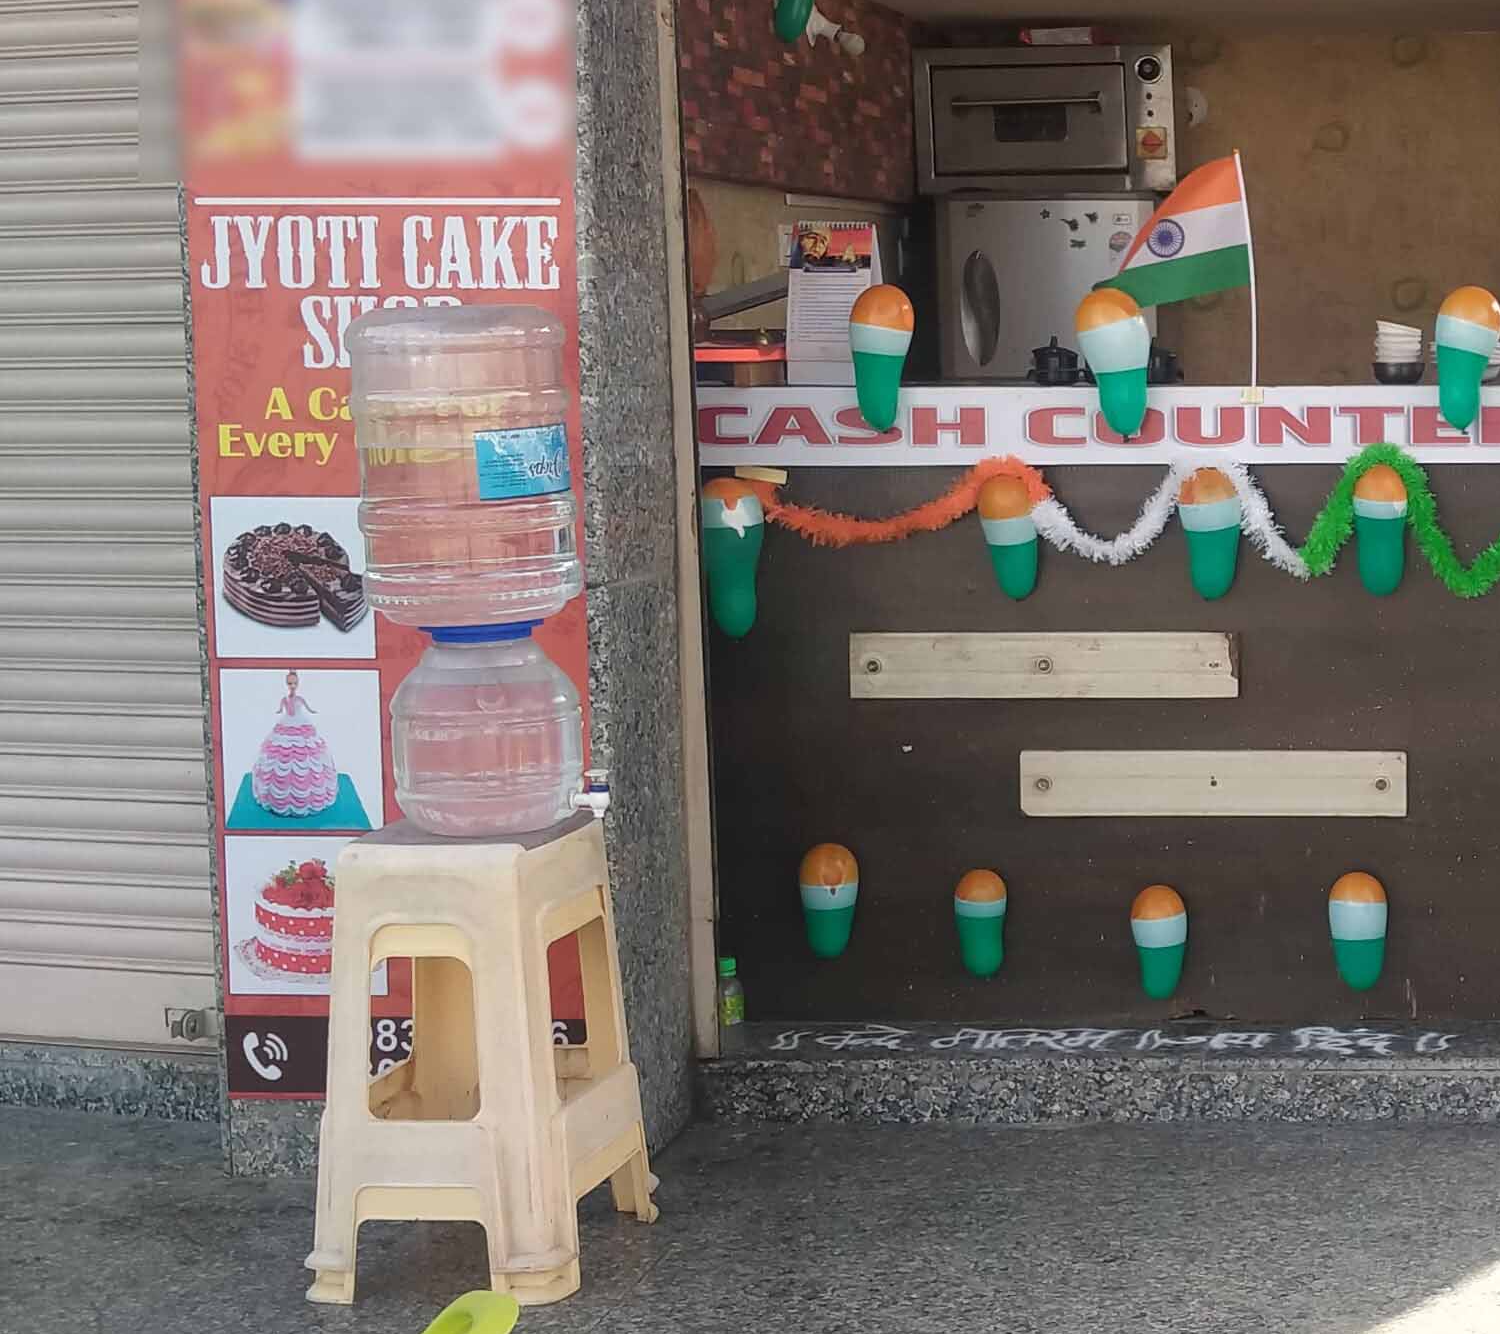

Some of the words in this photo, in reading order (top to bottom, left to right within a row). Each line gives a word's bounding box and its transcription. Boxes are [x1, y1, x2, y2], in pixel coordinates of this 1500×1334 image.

[200, 214, 382, 289] JYOTI
[402, 214, 561, 290] CAKE
[264, 387, 294, 421] A
[216, 423, 338, 466] Every
[696, 405, 988, 447] CASH
